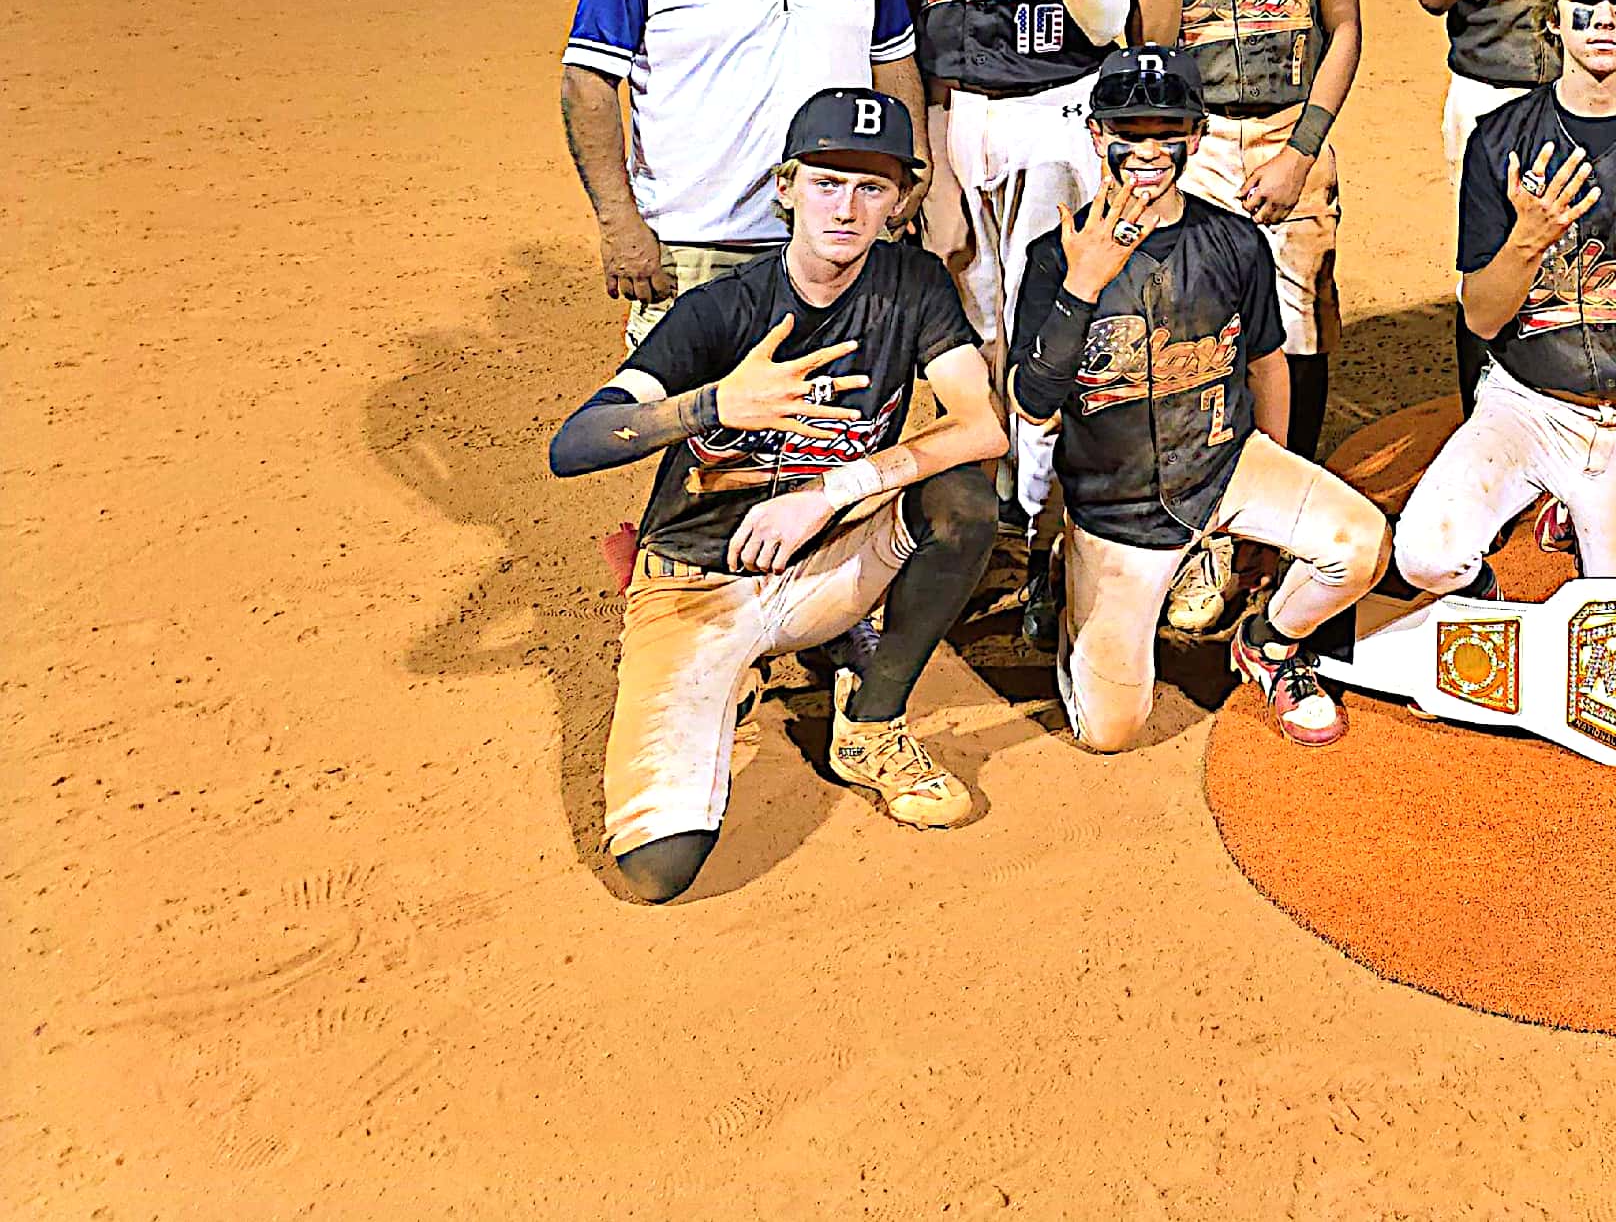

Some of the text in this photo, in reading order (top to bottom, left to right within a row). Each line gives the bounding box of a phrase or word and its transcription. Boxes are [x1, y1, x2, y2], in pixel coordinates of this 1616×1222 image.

[1014, 3, 1064, 55] 10
[854, 99, 882, 135] B
[1575, 719, 1616, 747] NATIONAL
